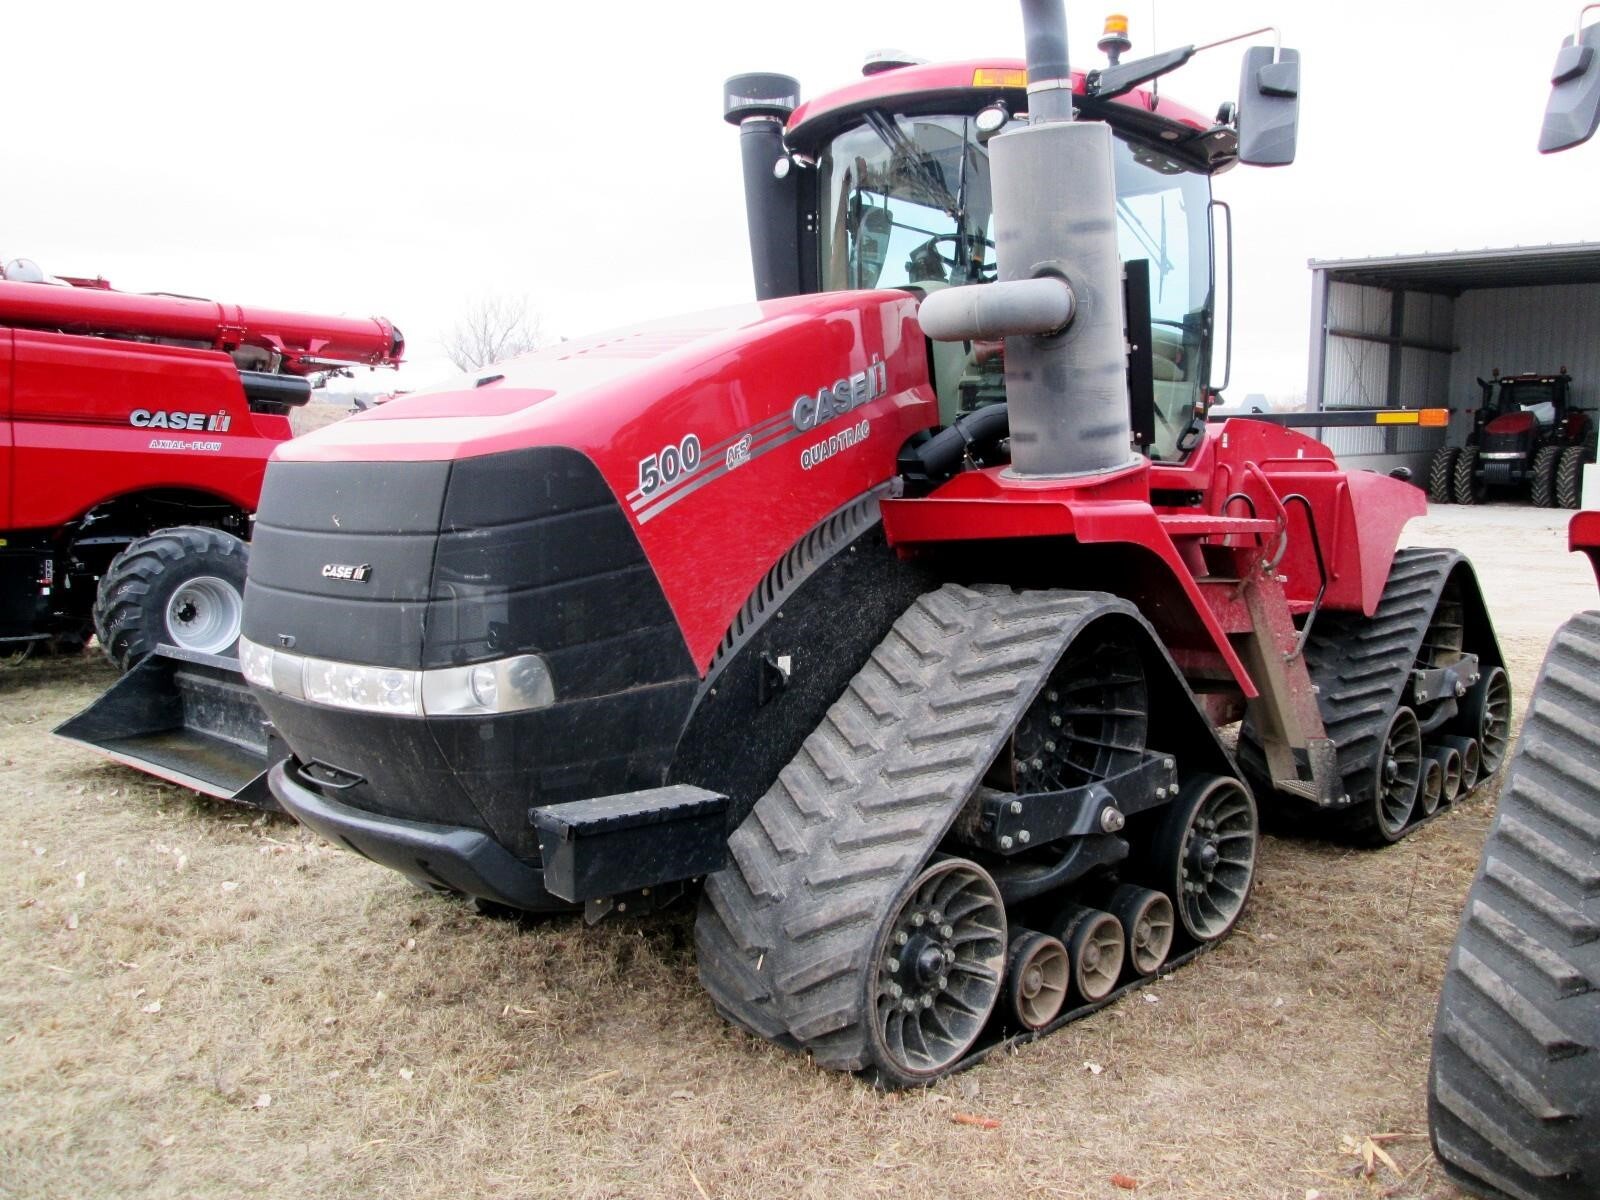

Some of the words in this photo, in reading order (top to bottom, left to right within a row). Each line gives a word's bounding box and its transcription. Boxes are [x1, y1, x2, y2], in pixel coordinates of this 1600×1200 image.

[129, 408, 206, 430] CASE
[793, 371, 866, 431] CASE
[149, 440, 222, 451] AXIAL-FLOW
[801, 419, 870, 470] QUADTRAC
[639, 433, 701, 496] 500
[322, 564, 353, 579] CASE
